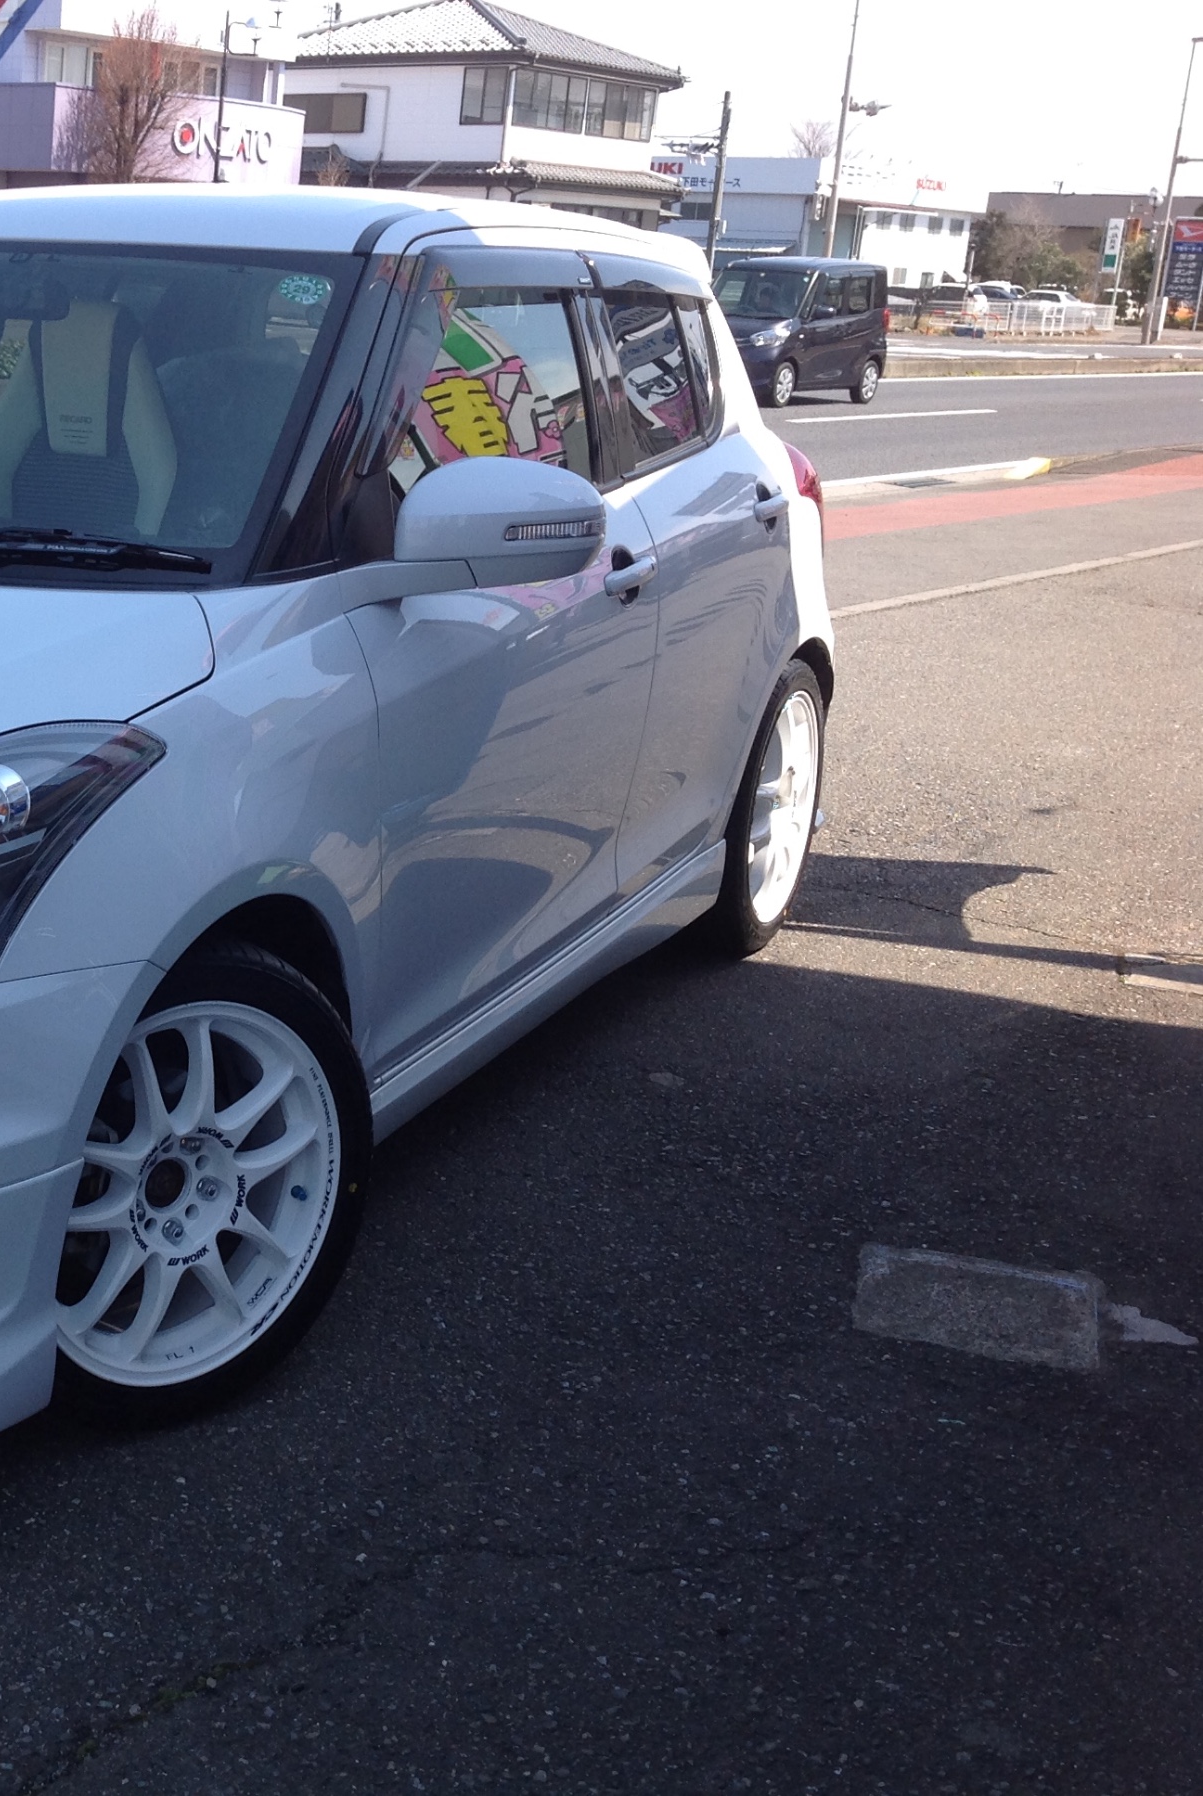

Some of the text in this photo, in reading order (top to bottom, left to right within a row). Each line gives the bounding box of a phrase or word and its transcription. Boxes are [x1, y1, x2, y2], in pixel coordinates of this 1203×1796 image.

[682, 176, 741, 187] 下田モーース
[196, 1126, 224, 1140] WORK
[235, 1174, 246, 1208] WORK
[131, 1225, 149, 1253] WORK
[181, 1244, 210, 1266] WORK
